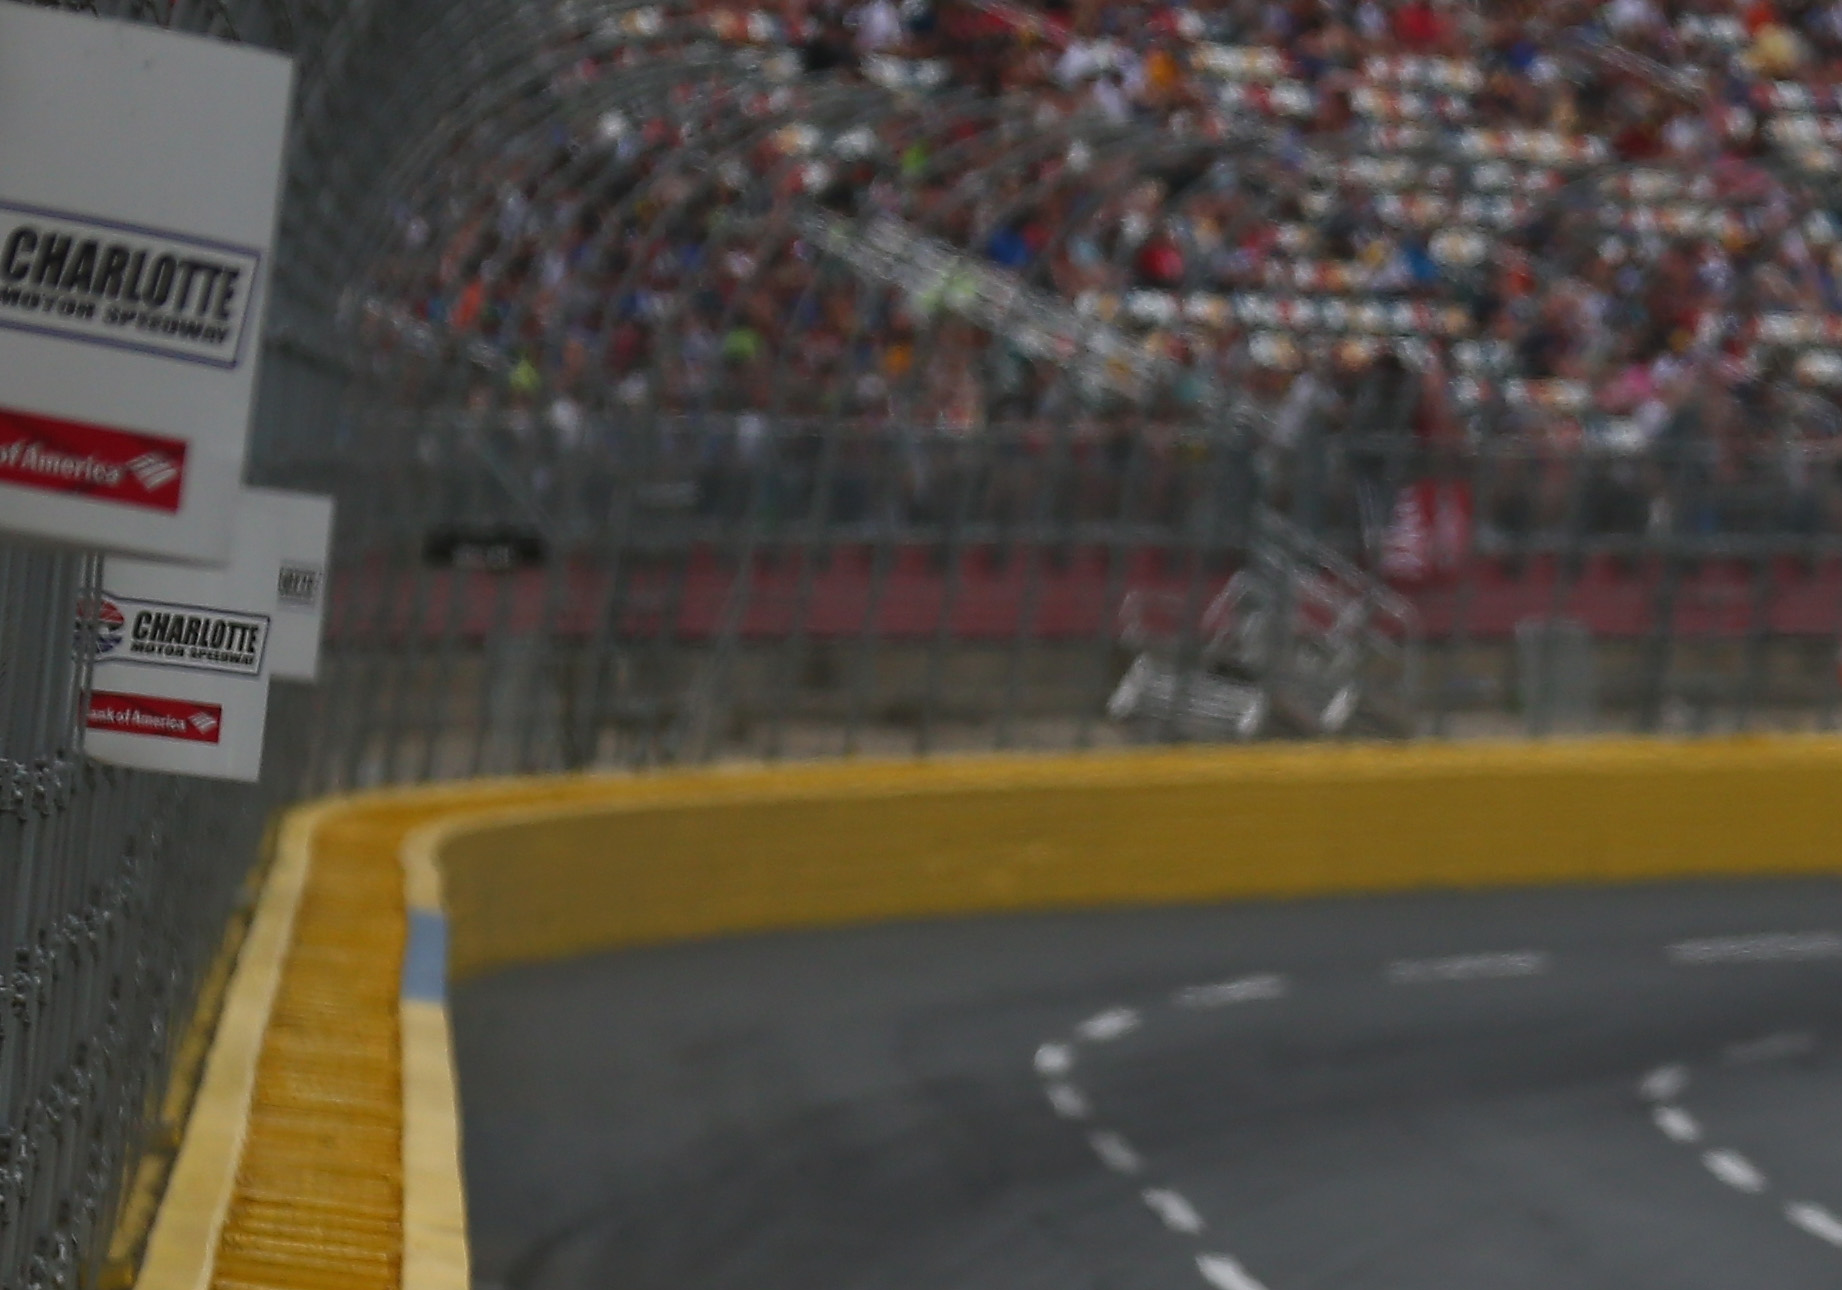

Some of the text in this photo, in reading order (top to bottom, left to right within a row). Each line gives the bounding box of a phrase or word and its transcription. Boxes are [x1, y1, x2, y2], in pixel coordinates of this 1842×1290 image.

[2, 226, 240, 320] CHARLOTTE
[103, 304, 230, 344] SPEEDWAY
[21, 442, 121, 486] America
[132, 610, 259, 653] CHARLOTTE
[130, 642, 256, 666] MOTOR SPEEDWAY
[132, 710, 187, 732] America
